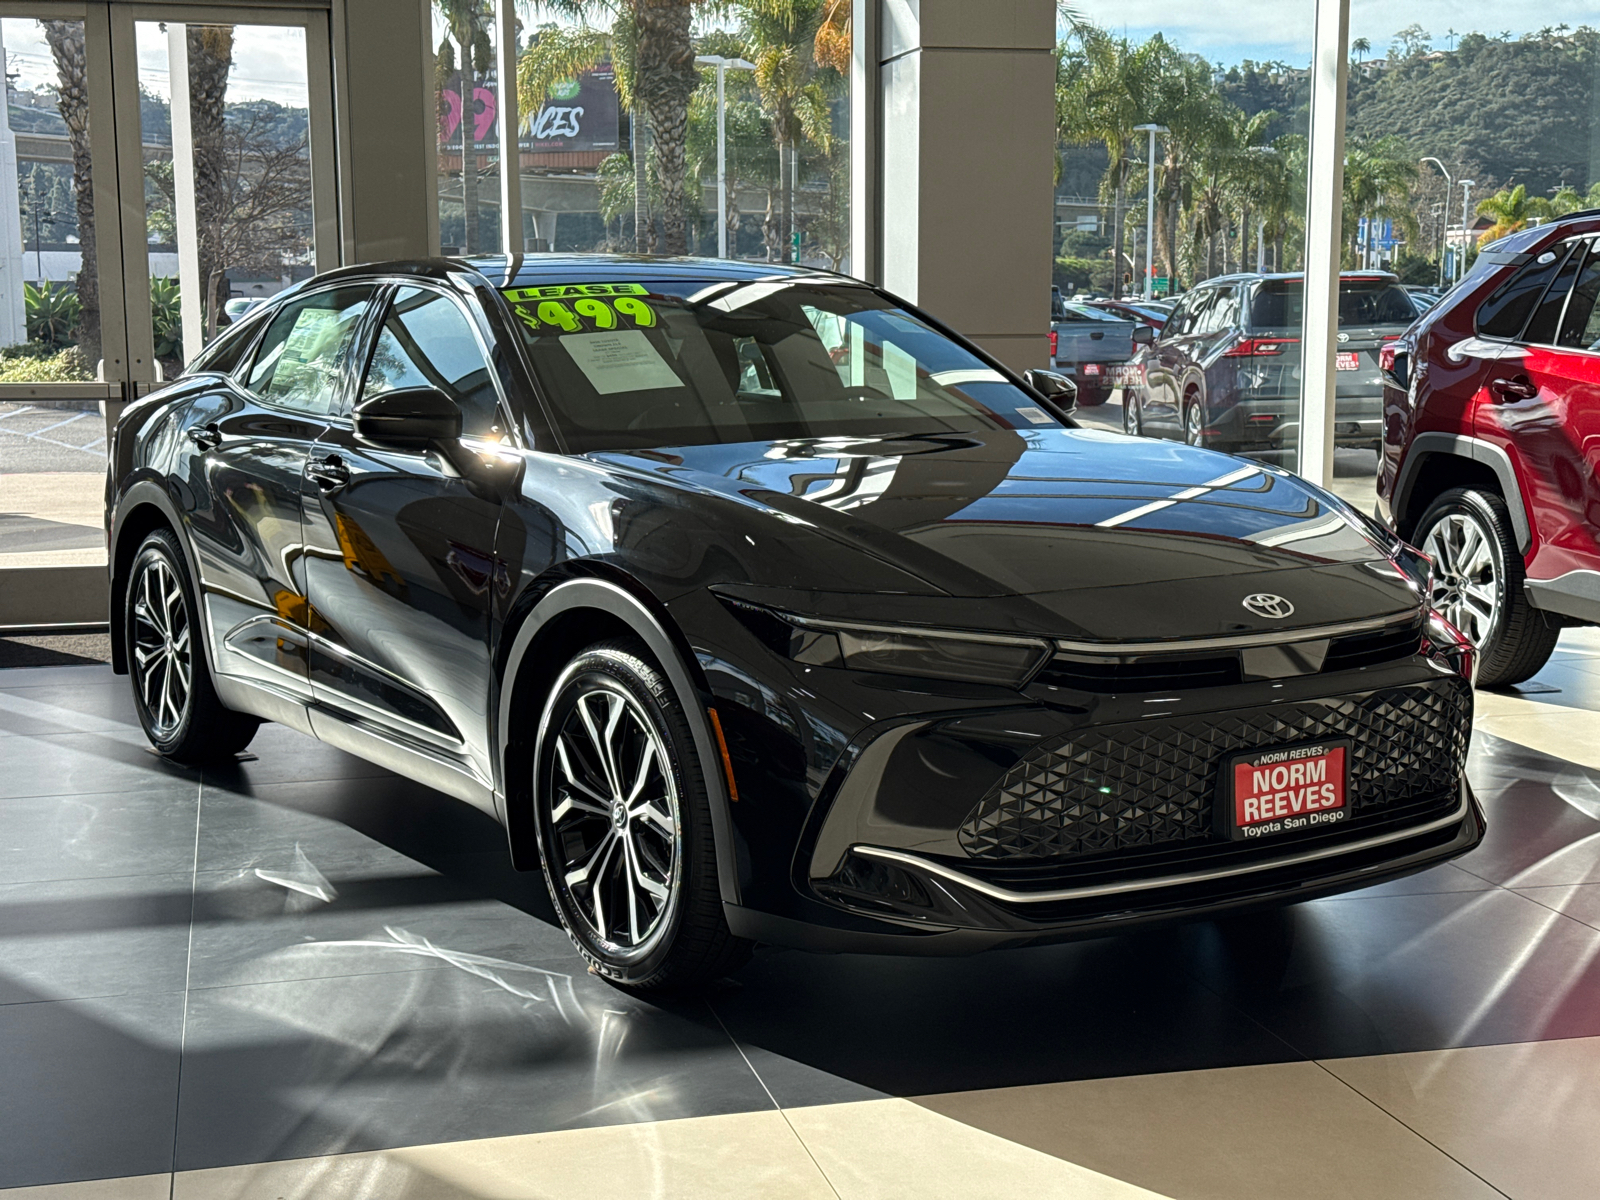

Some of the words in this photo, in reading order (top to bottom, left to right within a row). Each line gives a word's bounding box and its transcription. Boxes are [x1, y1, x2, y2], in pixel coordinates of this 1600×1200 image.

[516, 284, 637, 300] LEASE
[1260, 751, 1288, 765] NORM
[1289, 746, 1323, 760] REEVES
[1252, 759, 1327, 795] NORM
[1243, 783, 1336, 823] REEVES
[1241, 822, 1281, 838] Toyota
[1283, 818, 1307, 829] San
[1309, 810, 1344, 824] Diego
